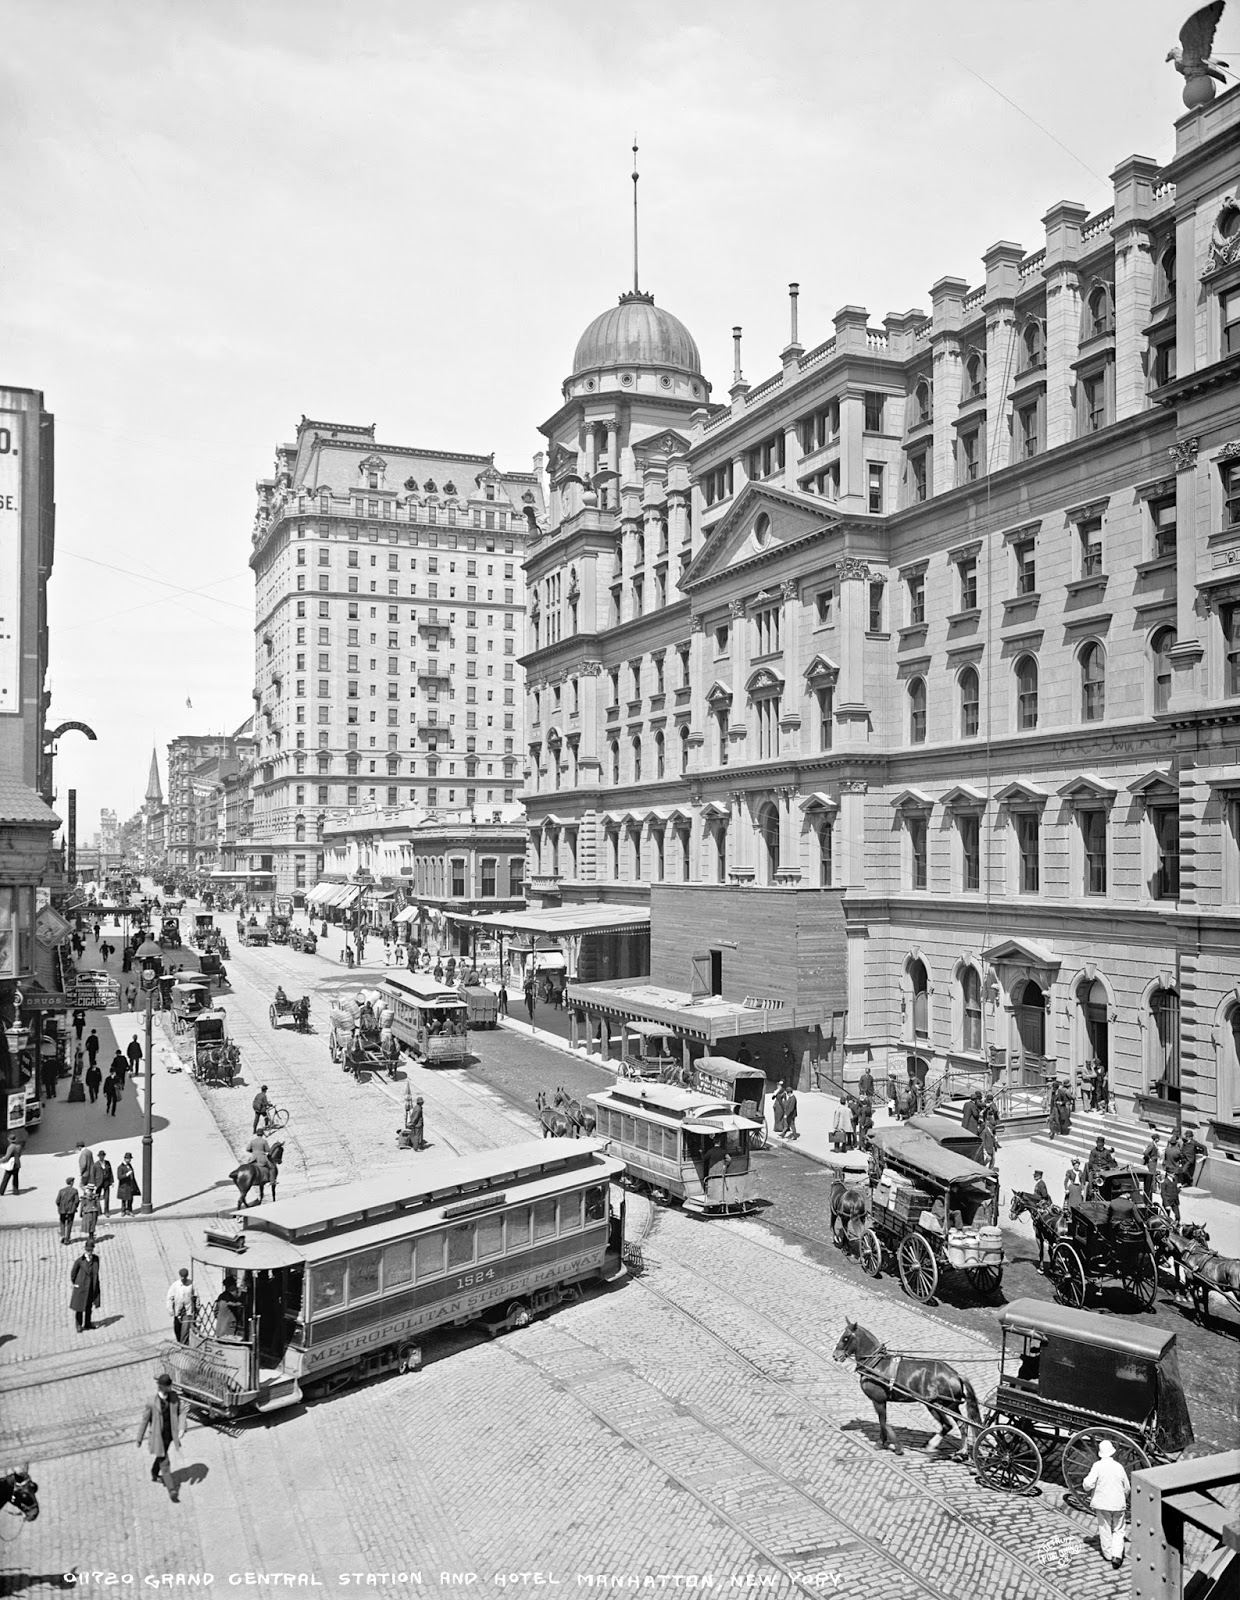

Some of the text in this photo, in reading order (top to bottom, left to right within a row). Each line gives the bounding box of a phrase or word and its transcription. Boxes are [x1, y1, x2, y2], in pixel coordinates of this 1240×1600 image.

[77, 998, 107, 1006] CIGARS
[457, 1268, 495, 1290] 1524
[308, 1252, 600, 1365] METROPOLITAN STREET RAILWAY
